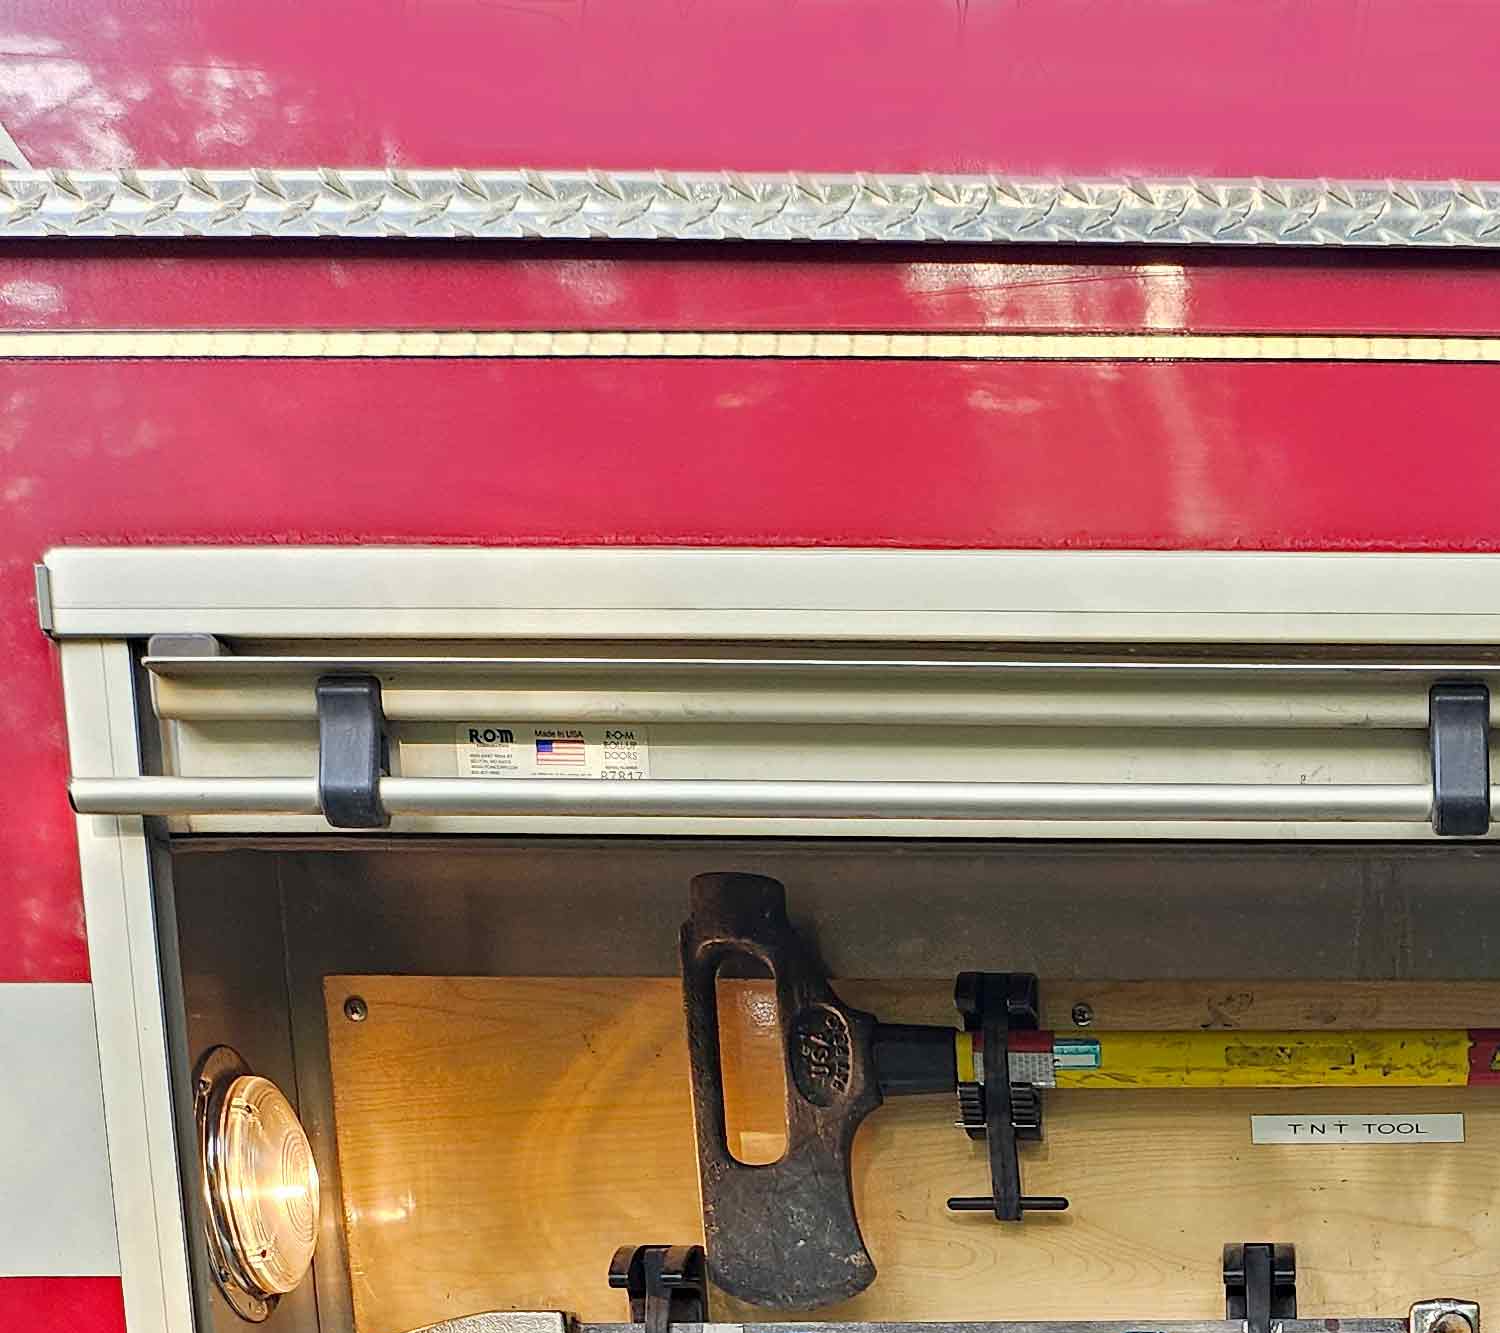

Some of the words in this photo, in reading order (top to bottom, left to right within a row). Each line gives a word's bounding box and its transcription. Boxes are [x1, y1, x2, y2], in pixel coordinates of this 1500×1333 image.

[604, 752, 638, 760] DOORS
[1288, 1122, 1349, 1135] TNT
[1362, 1122, 1429, 1134] TOOL
